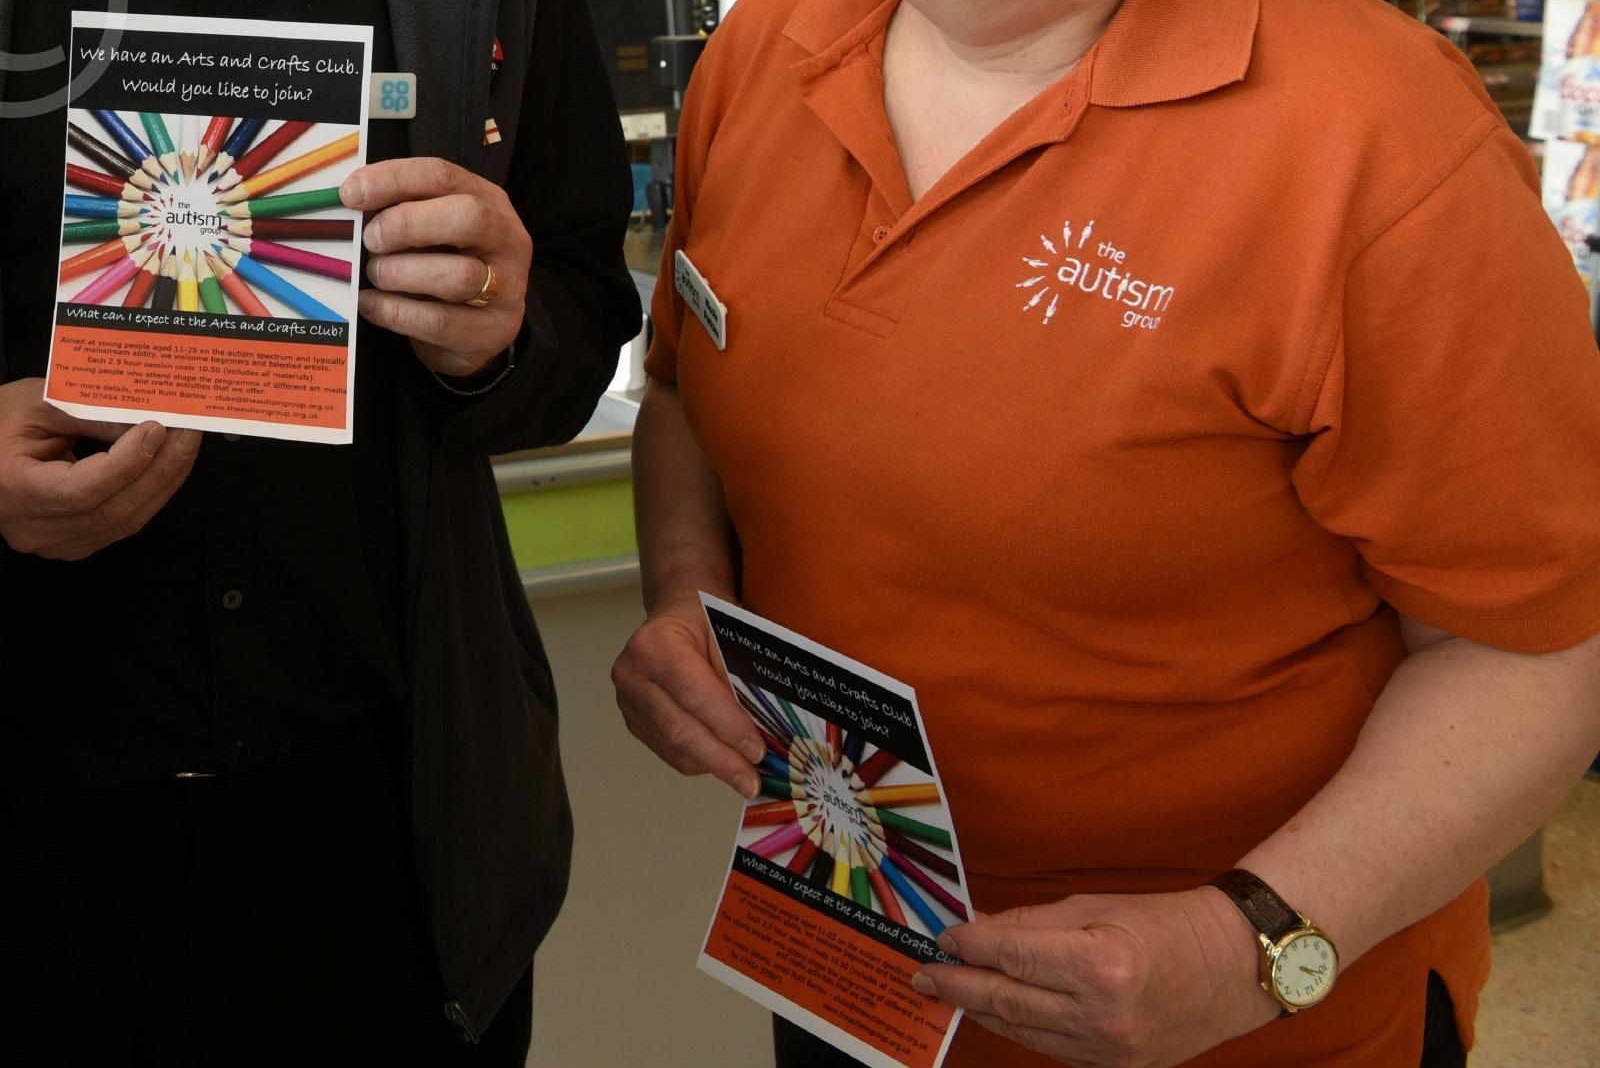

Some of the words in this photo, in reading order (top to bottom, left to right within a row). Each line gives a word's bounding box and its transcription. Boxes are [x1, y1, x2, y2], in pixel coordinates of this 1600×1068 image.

[80, 47, 105, 61] We
[111, 47, 146, 64] have
[151, 52, 174, 64] an
[177, 52, 215, 67] Arts
[220, 53, 252, 68] and
[258, 55, 310, 76] Crafts
[316, 58, 359, 74] Club.
[122, 78, 176, 92] Would
[181, 83, 212, 101] you
[218, 81, 249, 98] like
[253, 85, 269, 99] to
[269, 82, 312, 106] join?
[166, 211, 222, 226] autism
[178, 201, 190, 209] the
[200, 227, 221, 235] group
[1097, 241, 1126, 264] the
[1057, 257, 1175, 311] autism
[67, 308, 100, 320] What
[103, 312, 125, 321] can
[128, 313, 132, 321] I
[135, 314, 170, 327] expect
[173, 315, 186, 325] at
[188, 316, 206, 328] the
[209, 318, 236, 329] Arts
[240, 320, 264, 332] and
[268, 322, 306, 337] Crafts
[310, 325, 344, 337] Club?
[61, 336, 85, 344] Aimed
[98, 340, 122, 349] young
[124, 342, 150, 351] people
[153, 344, 172, 352] aged
[212, 348, 225, 356] the
[227, 350, 254, 358] autism
[256, 352, 293, 361] spectrum
[313, 356, 346, 366] typically
[84, 347, 130, 356] mainstream
[133, 350, 158, 359] ability,
[174, 352, 208, 362] welcome
[210, 356, 249, 365] beginners
[252, 359, 266, 367] and
[269, 360, 301, 370] talented
[304, 364, 331, 372] artists.
[88, 356, 106, 364] Each
[124, 359, 142, 367] hour
[198, 365, 221, 373] 10.50
[224, 367, 259, 377] (includes
[261, 369, 270, 377] all
[103, 384, 131, 393] details,
[134, 387, 155, 395] email
[159, 389, 177, 397] Ruth
[180, 391, 206, 400] Barlow
[716, 624, 735, 641] We
[736, 632, 762, 654] have
[765, 648, 781, 661] an
[784, 656, 810, 676] Arts
[812, 670, 836, 689] and
[839, 683, 879, 710] Crafts
[882, 704, 916, 729] Club.
[753, 661, 793, 688] Would
[795, 683, 819, 702] you
[820, 693, 843, 715] like
[845, 707, 858, 721] to
[859, 710, 889, 737] join?
[823, 790, 863, 822] autism
[742, 854, 768, 873] What
[769, 870, 786, 884] can
[789, 877, 793, 886] I
[794, 881, 823, 901] expect
[824, 896, 836, 908] at
[836, 900, 853, 916] the
[852, 910, 876, 927] Arts
[878, 923, 900, 939] and
[901, 933, 934, 954] Crafts
